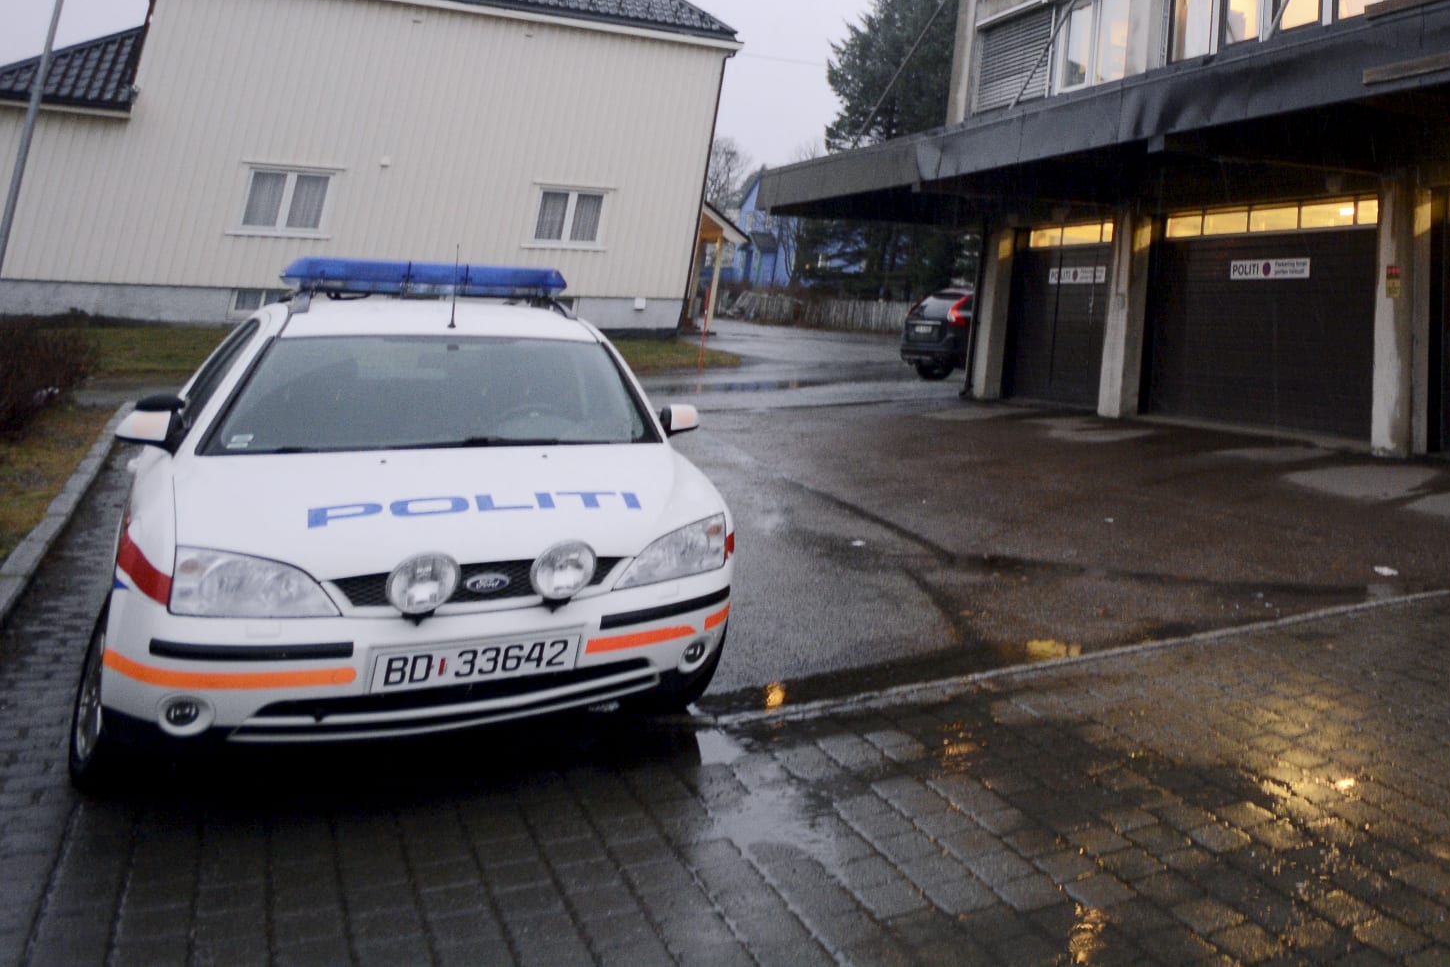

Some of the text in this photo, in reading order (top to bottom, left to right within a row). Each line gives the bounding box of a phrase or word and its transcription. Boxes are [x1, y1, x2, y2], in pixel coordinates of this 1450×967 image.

[1232, 263, 1259, 276] POLITI
[307, 491, 642, 529] POLITI
[383, 639, 569, 687] BD 33642
